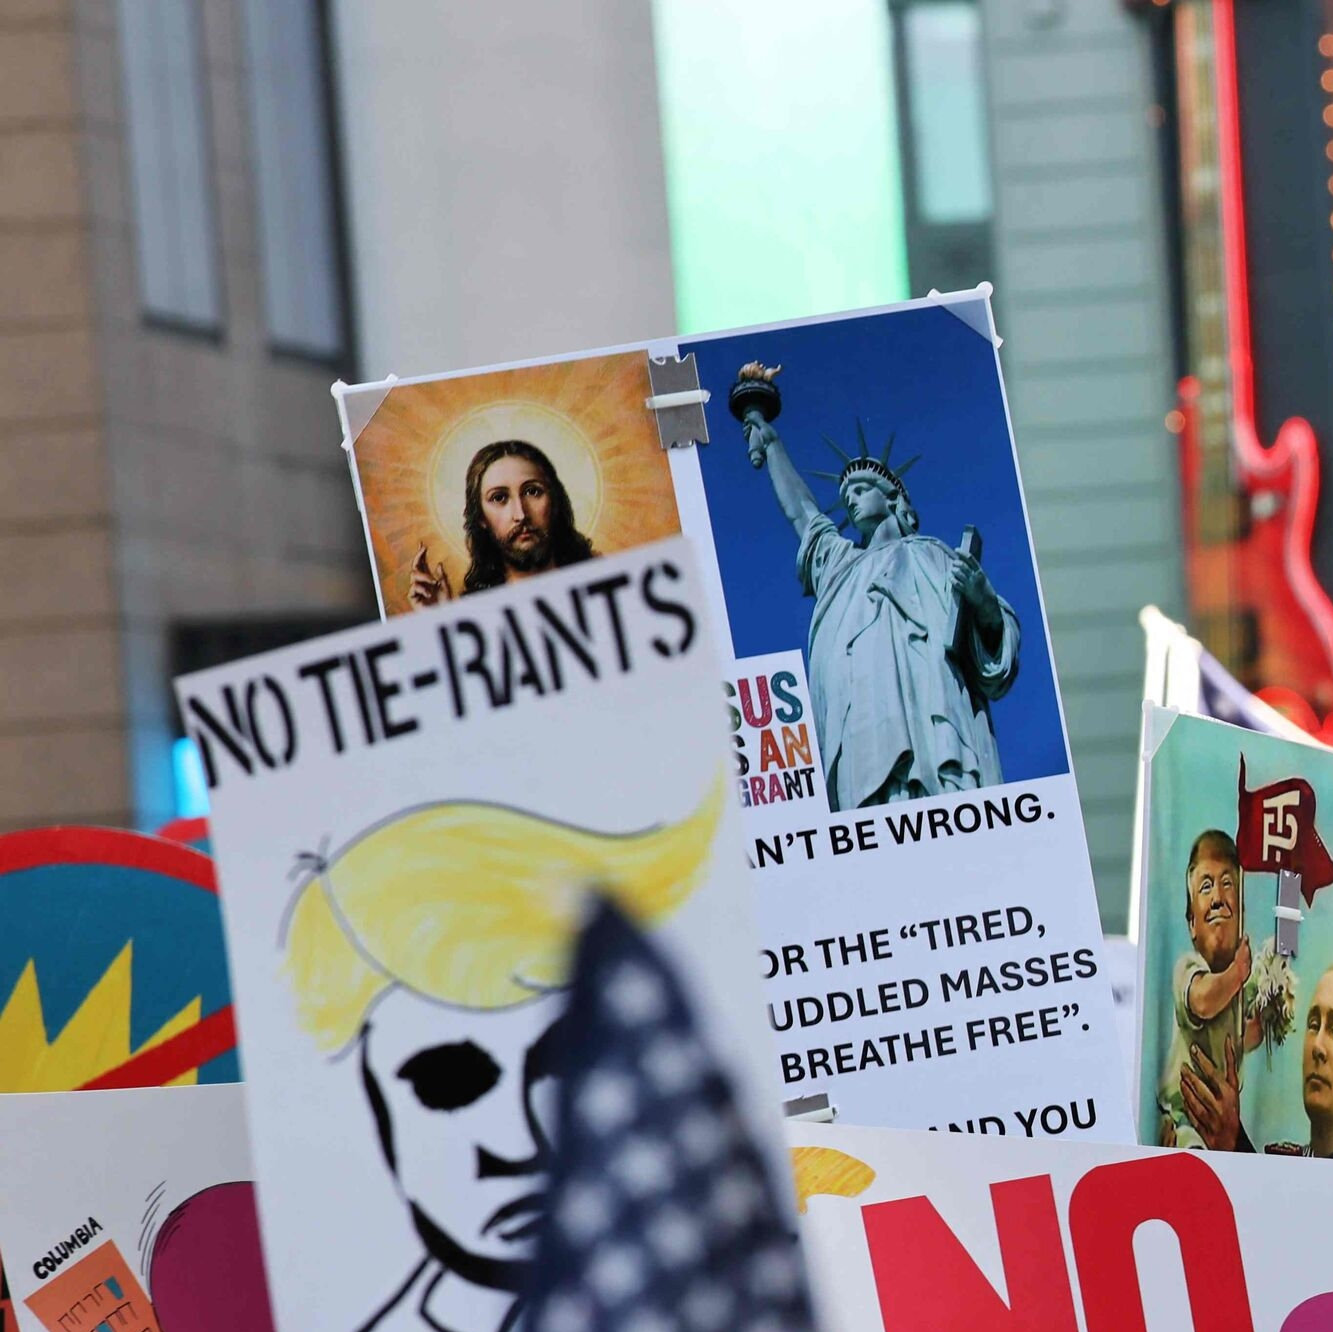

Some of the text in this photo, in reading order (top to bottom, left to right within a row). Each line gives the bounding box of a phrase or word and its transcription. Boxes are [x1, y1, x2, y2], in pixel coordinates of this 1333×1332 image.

[186, 562, 697, 789] NO TIE-RANTS
[760, 723, 813, 772] AN
[829, 820, 878, 855] BE
[885, 793, 1055, 844] WRONG.
[814, 929, 892, 968] THE
[940, 949, 1097, 1002] MASSES
[780, 1025, 957, 1084] BREATHE
[1013, 1098, 1096, 1138] YOU
[32, 1216, 104, 1280] COLUMBIA
